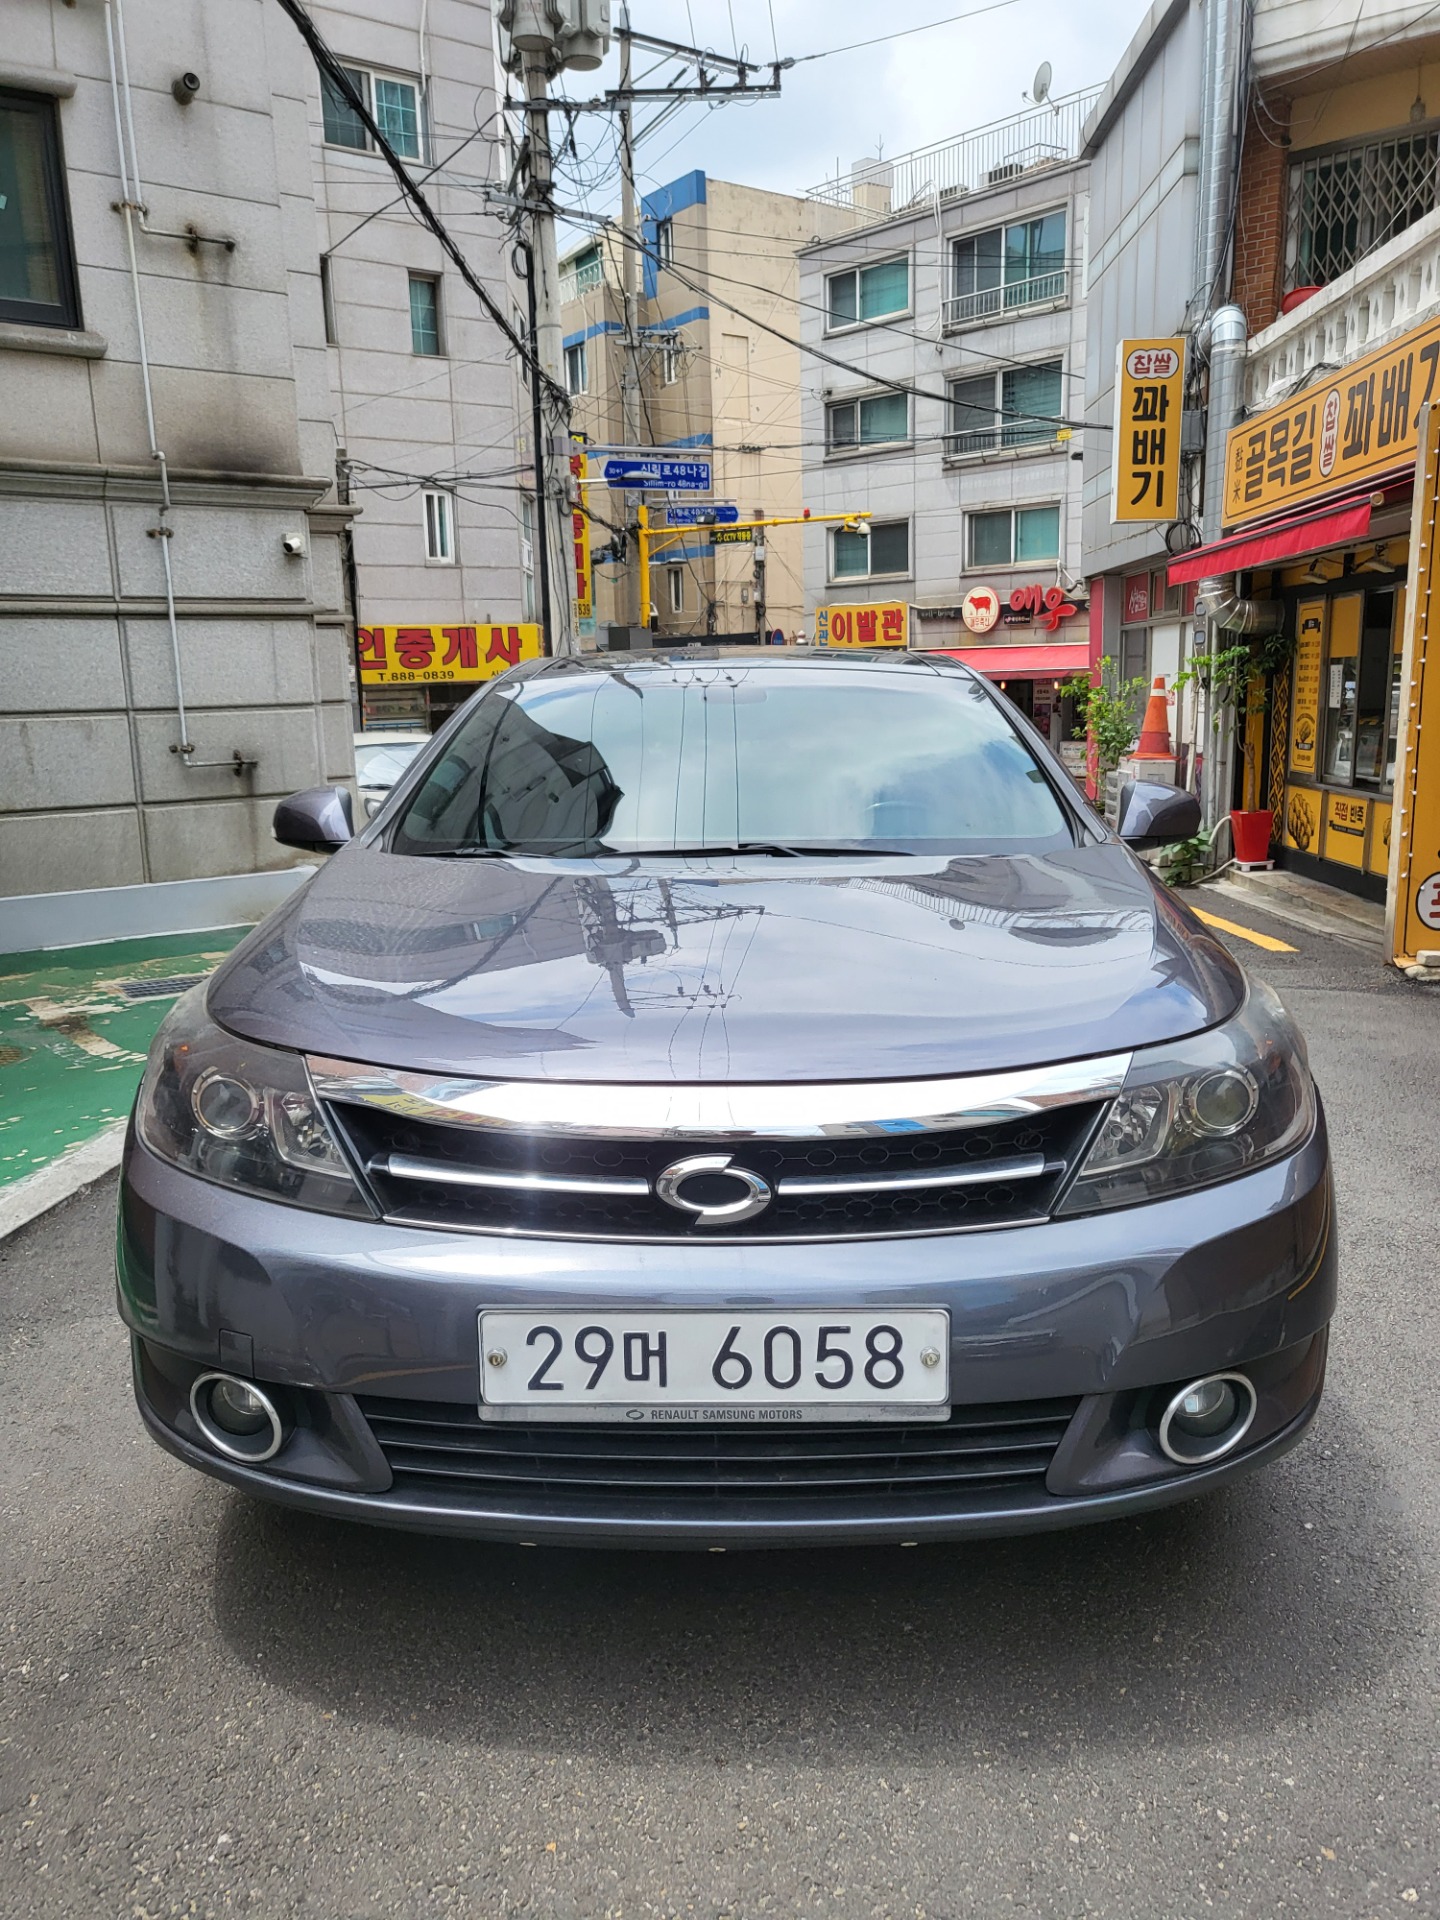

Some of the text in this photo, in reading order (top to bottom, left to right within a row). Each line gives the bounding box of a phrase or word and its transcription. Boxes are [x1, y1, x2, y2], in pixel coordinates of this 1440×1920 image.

[1134, 352, 1172, 375] 찹쌀
[1131, 384, 1169, 507] 꽈배기
[1322, 398, 1339, 469] 찹쌀
[1244, 404, 1316, 503] 골목길
[723, 532, 737, 542] CCTV
[818, 611, 828, 647] 신관
[831, 608, 903, 643] 이발관
[377, 671, 455, 682] T.888-0839
[1334, 801, 1349, 821] 직접
[526, 1324, 905, 1391] 29머 6058
[651, 1410, 803, 1420] RENAULT SAMSUNG MOTORS
